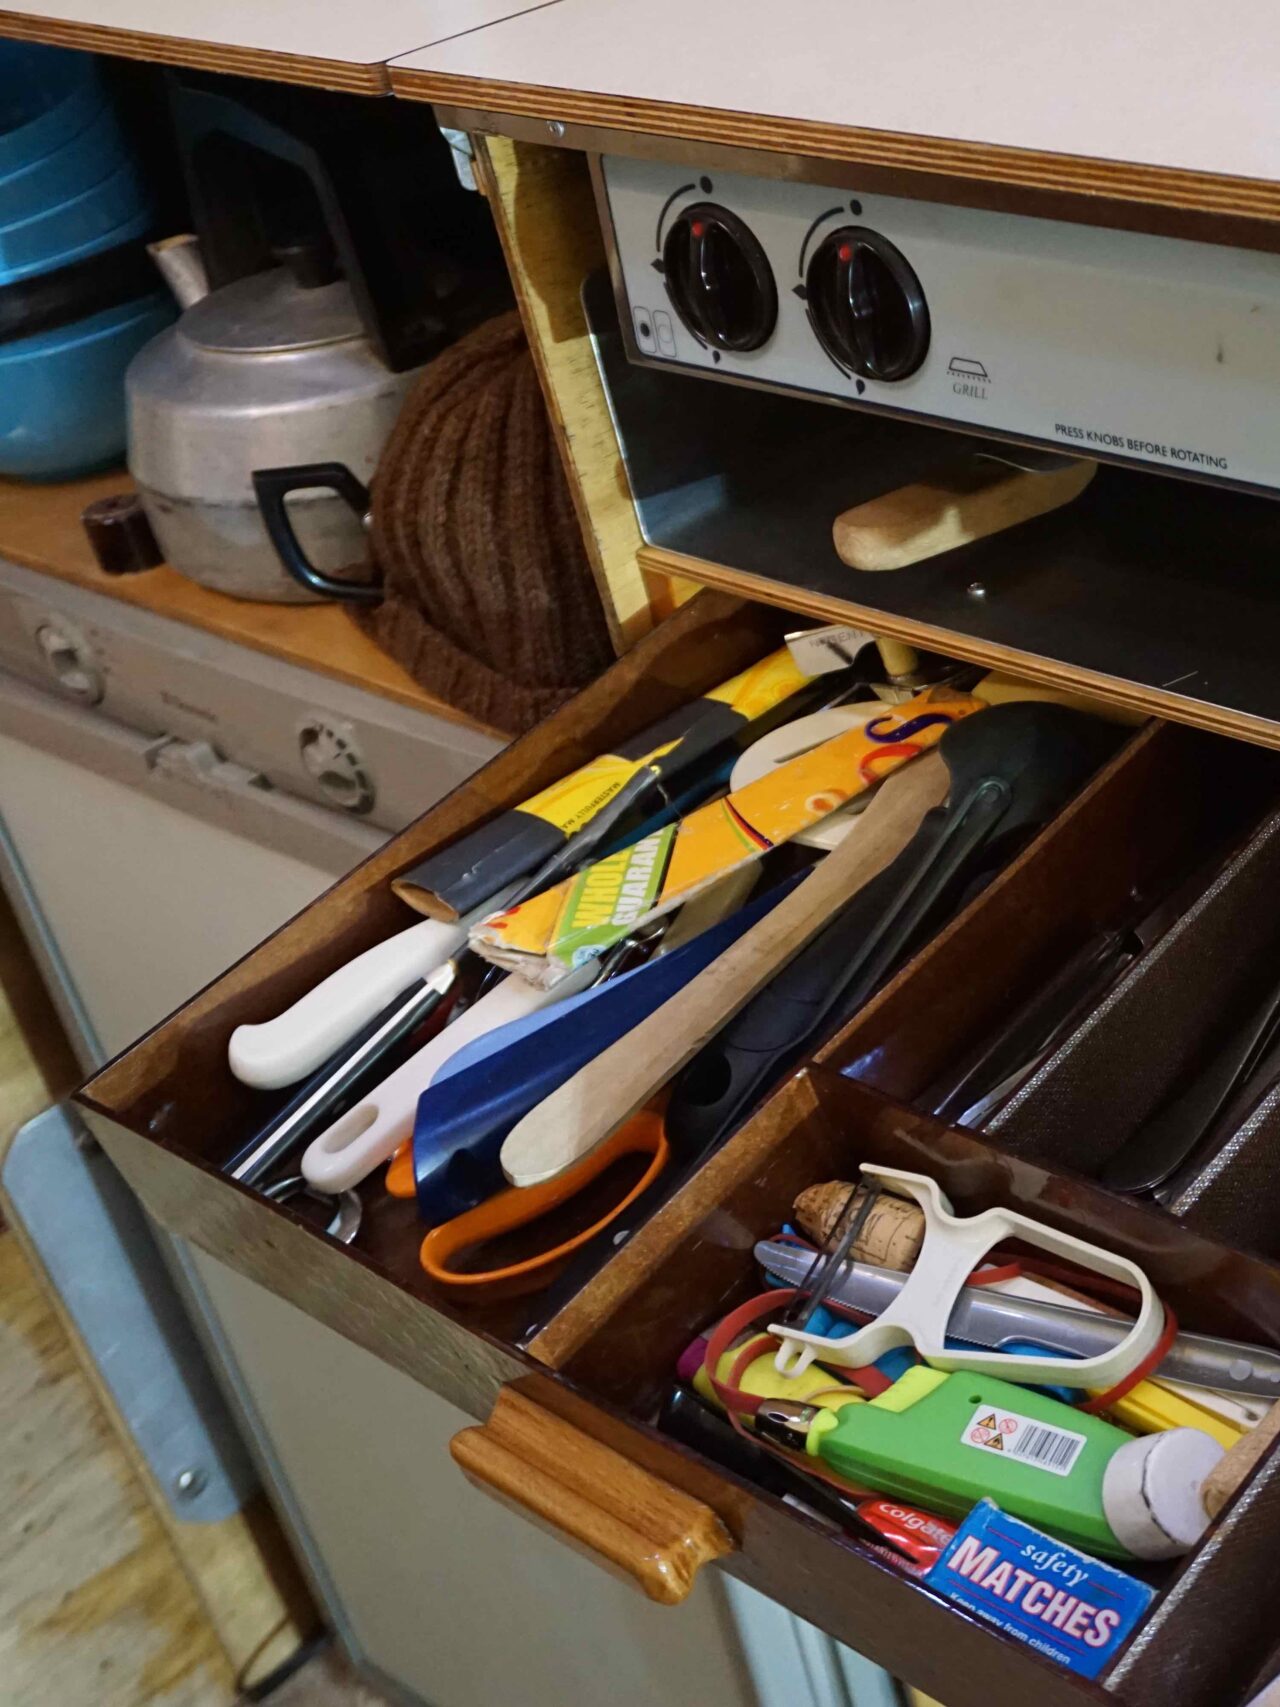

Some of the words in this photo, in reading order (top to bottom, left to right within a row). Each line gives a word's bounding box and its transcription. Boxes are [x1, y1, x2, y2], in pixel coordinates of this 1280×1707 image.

[952, 382, 988, 400] GRILL
[1055, 423, 1084, 440] PRESS
[1086, 431, 1125, 448] KNOBS
[1127, 438, 1168, 457] BEFORE
[1170, 449, 1228, 470] ROTATING
[611, 829, 665, 926] GUARAN
[1020, 1541, 1090, 1587] safety
[947, 1536, 1120, 1648] MATCHES
[1003, 1622, 1029, 1643] from
[1028, 1637, 1072, 1665] children
